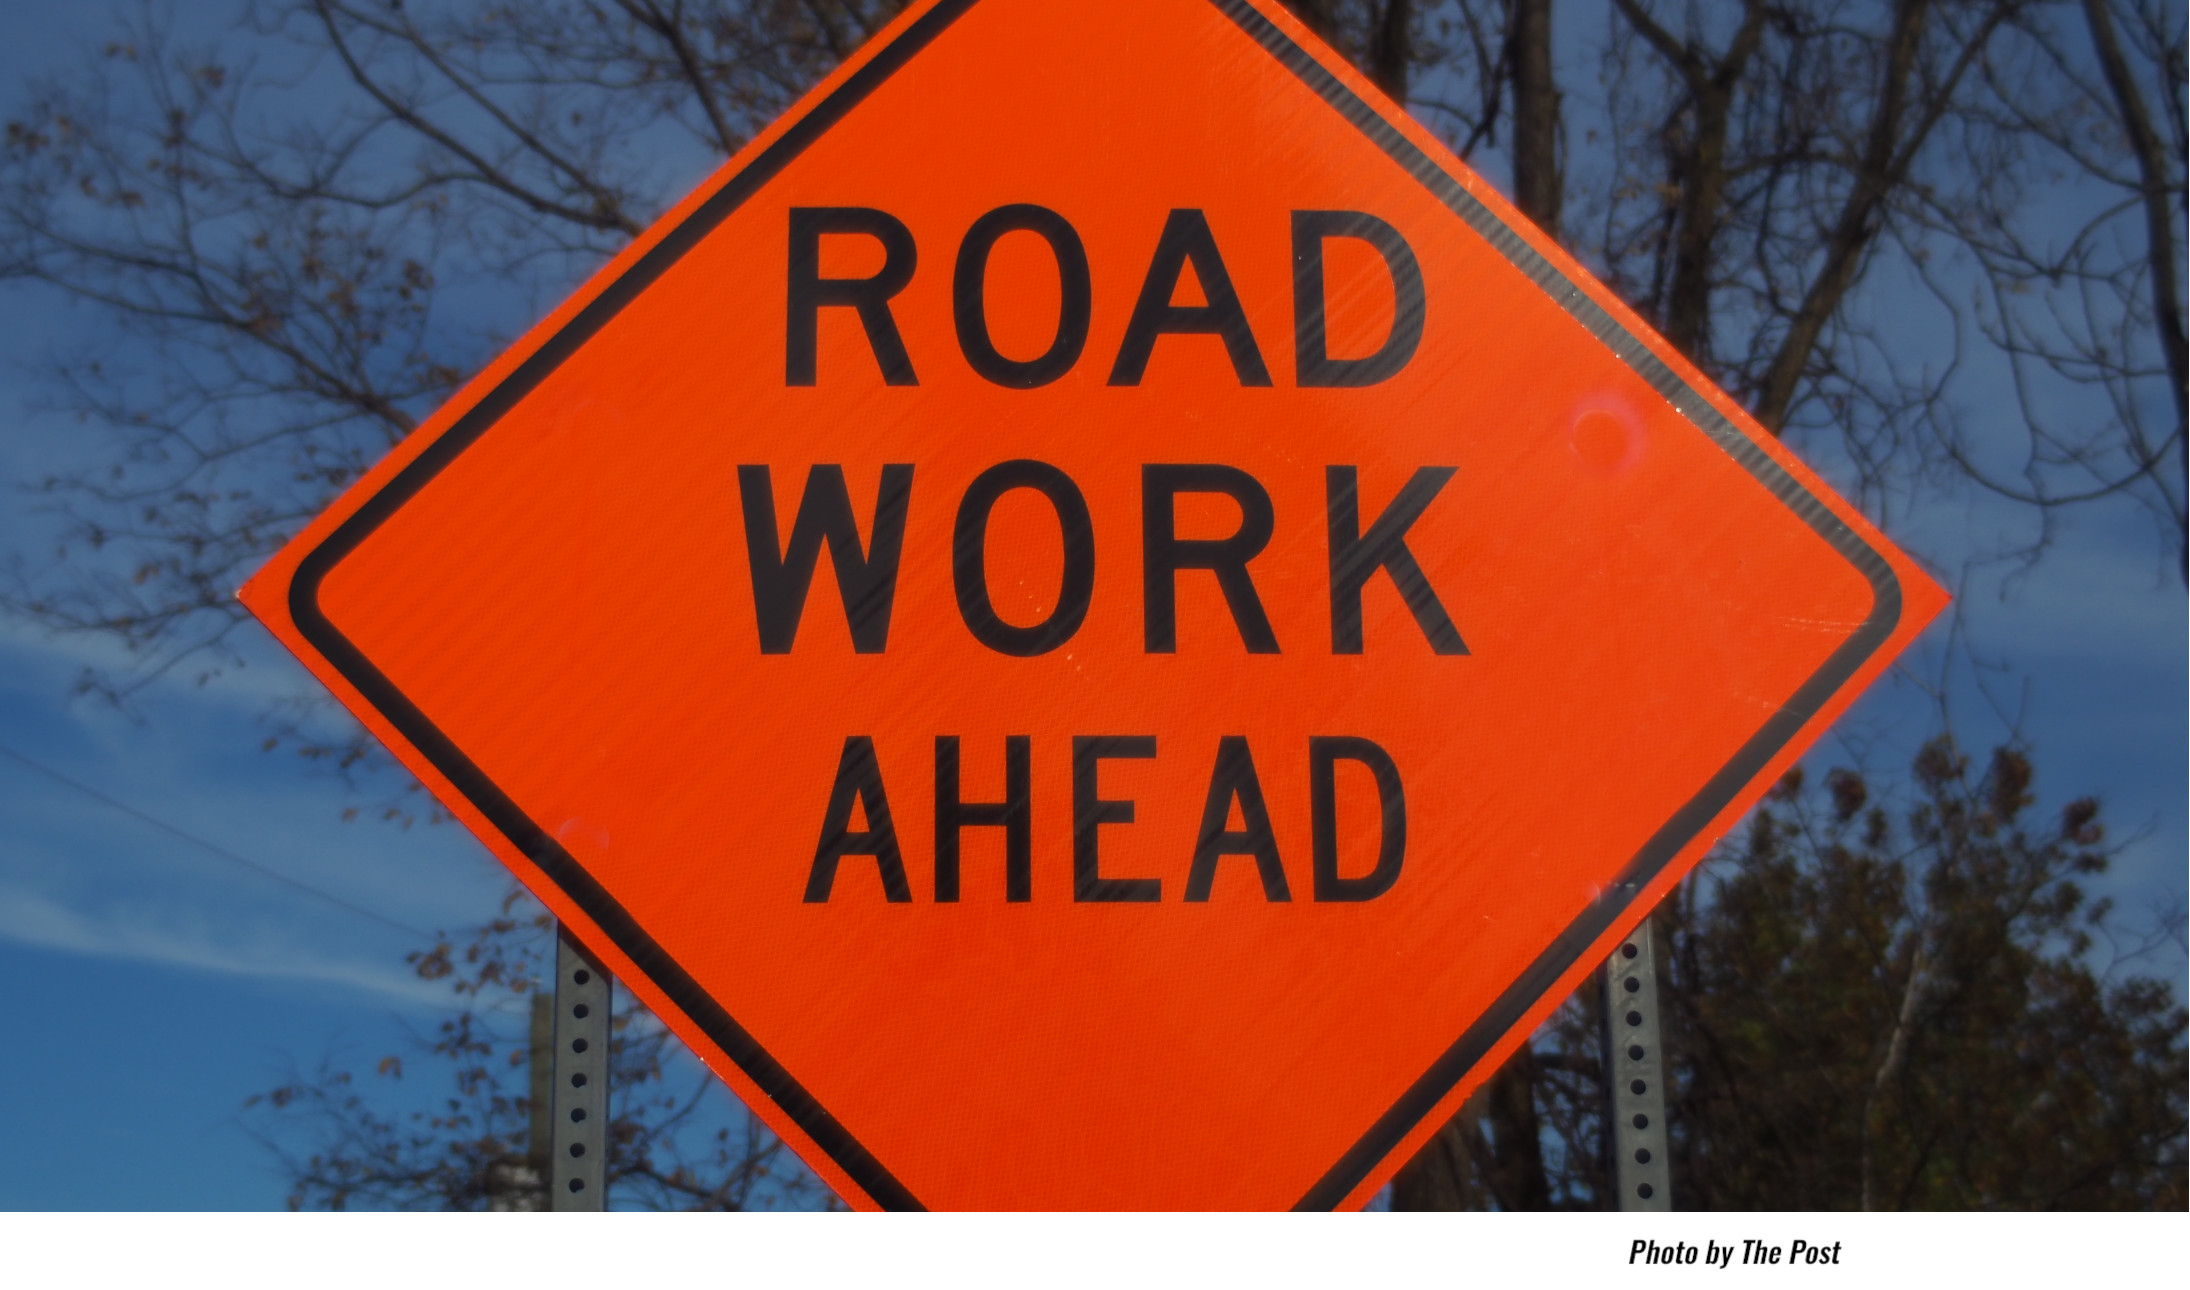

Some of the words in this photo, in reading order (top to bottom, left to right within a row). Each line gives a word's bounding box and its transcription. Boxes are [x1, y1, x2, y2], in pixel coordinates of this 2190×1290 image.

[785, 203, 1426, 389] ROAD
[737, 458, 1470, 658] WORK
[802, 735, 1407, 904] AHEAD
